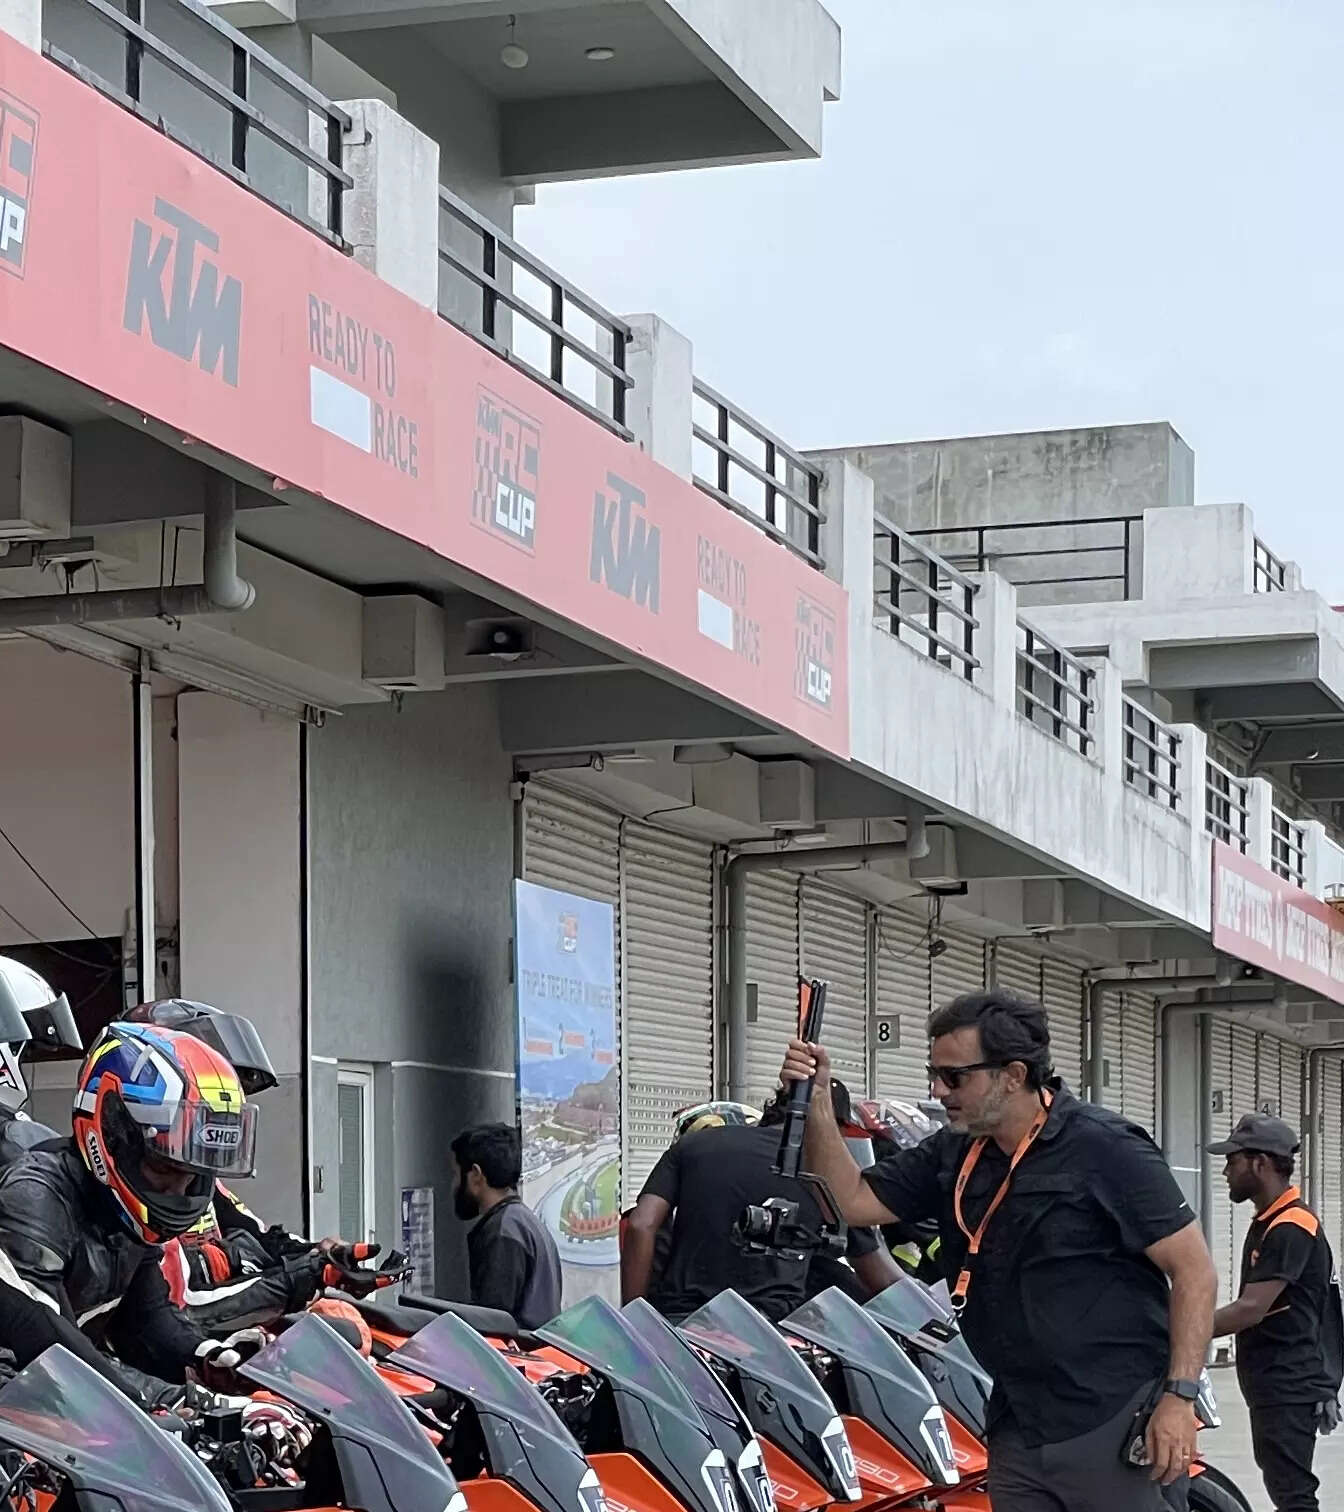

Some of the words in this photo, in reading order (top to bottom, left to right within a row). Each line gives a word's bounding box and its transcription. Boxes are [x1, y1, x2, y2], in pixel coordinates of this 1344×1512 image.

[123, 195, 243, 388] KTM
[308, 292, 369, 382] READY
[373, 332, 395, 398] TO
[373, 400, 419, 479] RACE
[495, 482, 535, 538] CUP
[590, 472, 662, 615] KTM
[807, 661, 832, 703] CUP
[877, 1023, 890, 1042] 8
[841, 1446, 856, 1479] 0
